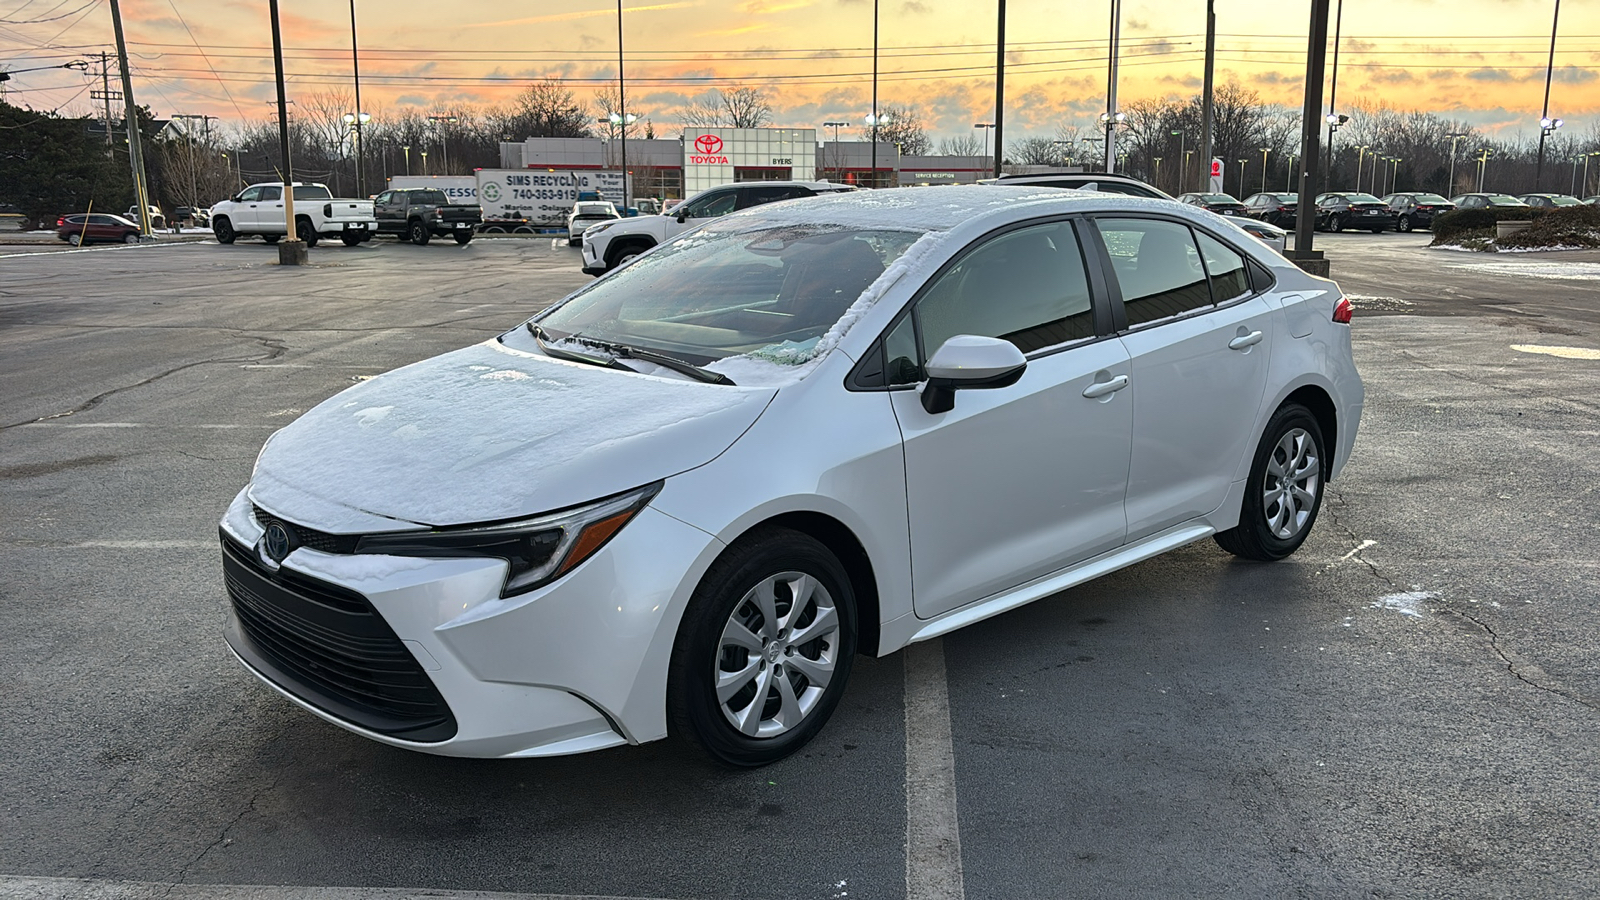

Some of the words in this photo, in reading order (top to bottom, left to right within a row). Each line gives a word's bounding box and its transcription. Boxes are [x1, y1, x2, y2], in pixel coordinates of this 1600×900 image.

[689, 156, 729, 164] TOYOTA
[506, 175, 531, 186] SIMS
[513, 189, 582, 200] 740-363-919
